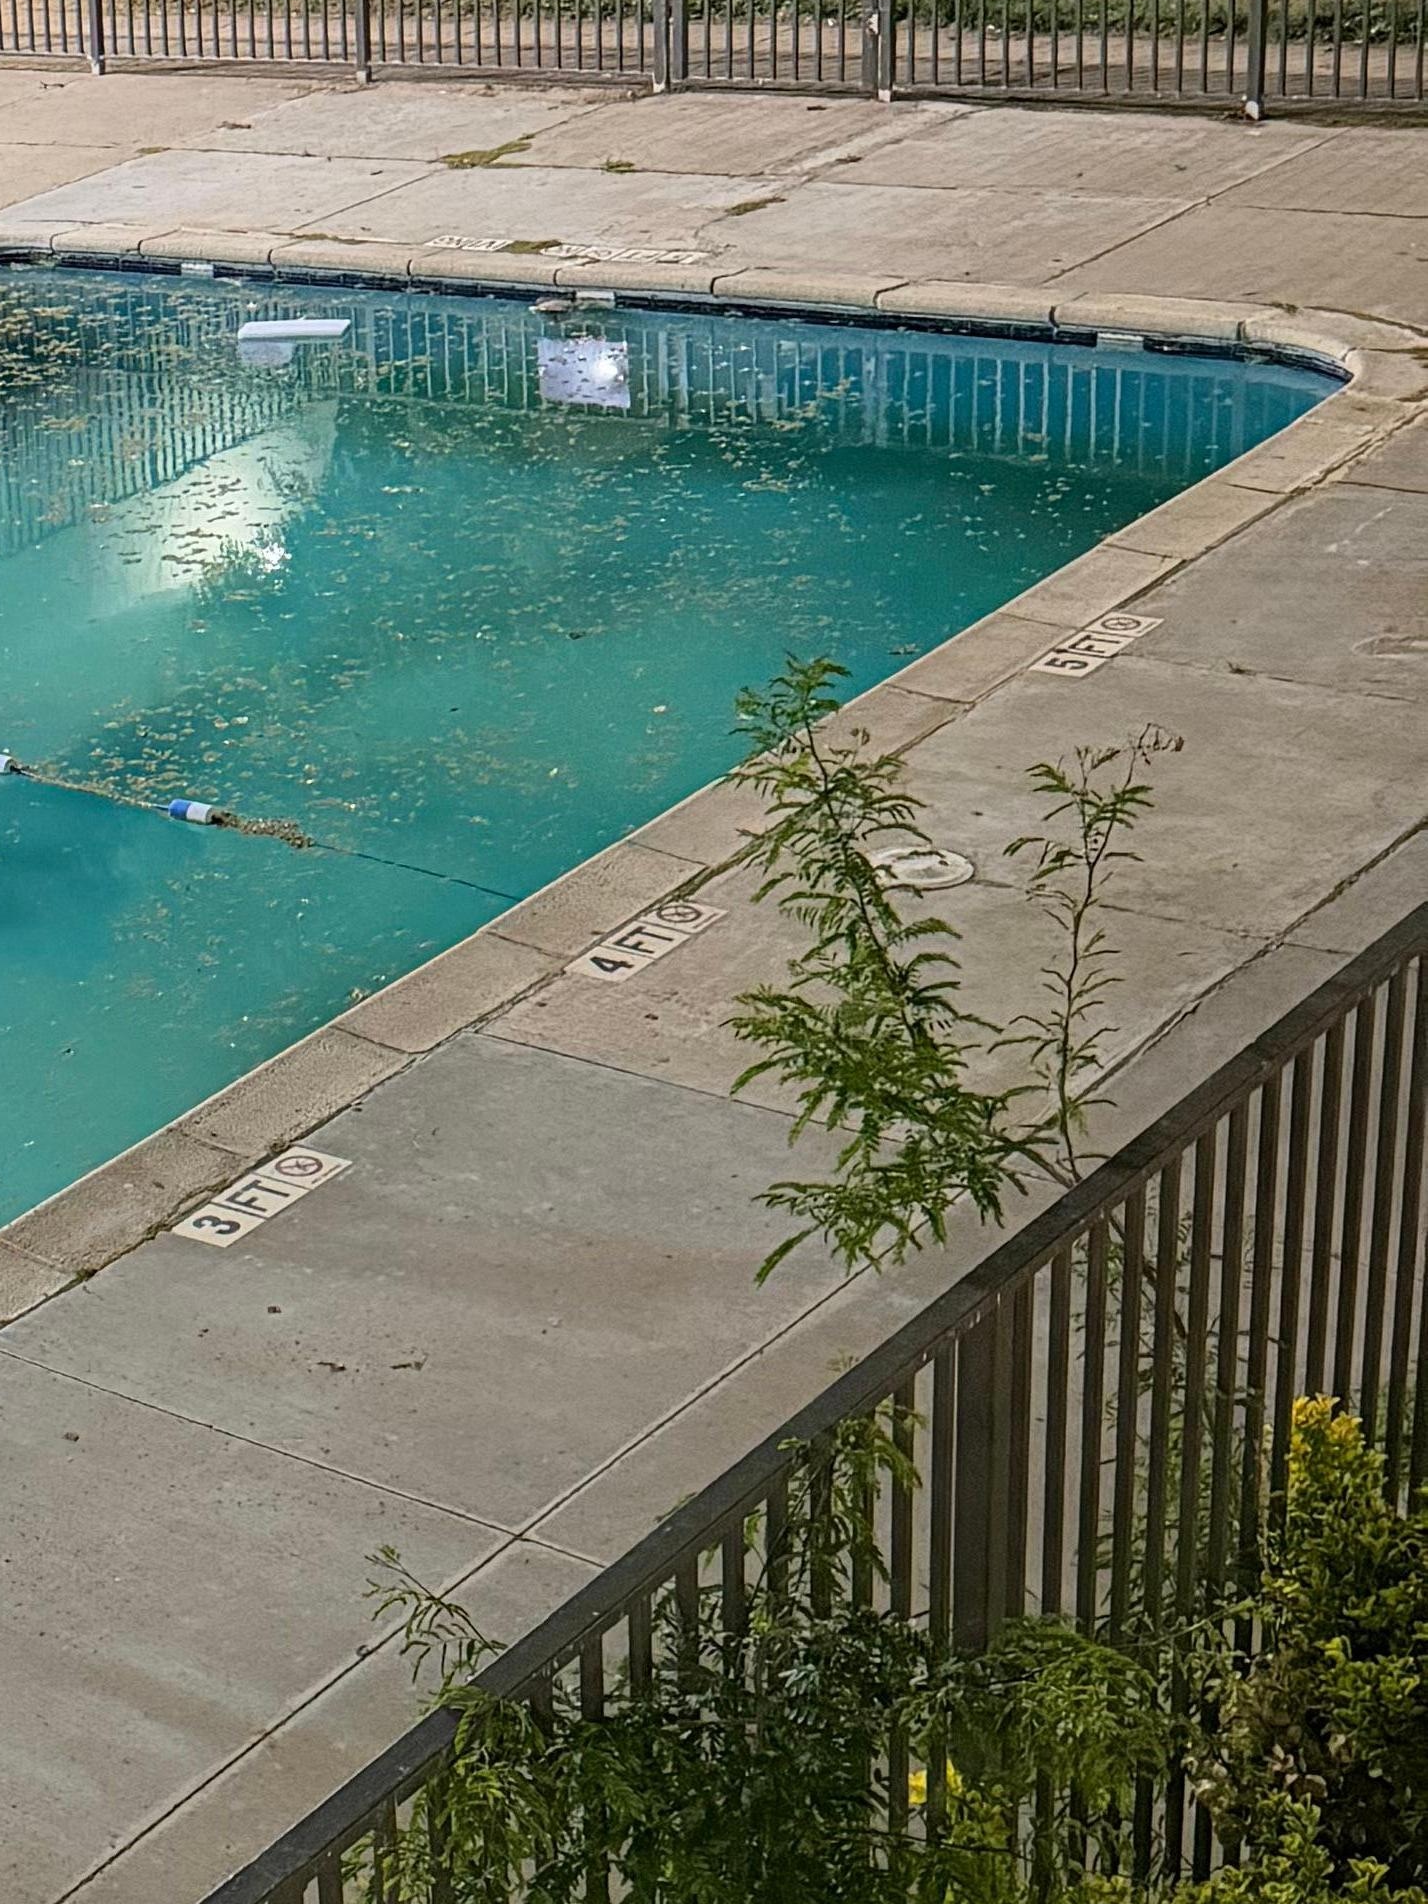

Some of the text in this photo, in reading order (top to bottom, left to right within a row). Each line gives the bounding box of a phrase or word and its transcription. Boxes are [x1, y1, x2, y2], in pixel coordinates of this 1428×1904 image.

[1044, 634, 1122, 670] 5 FT
[590, 926, 675, 973] 4 FT
[192, 1179, 291, 1235] 3 FT
